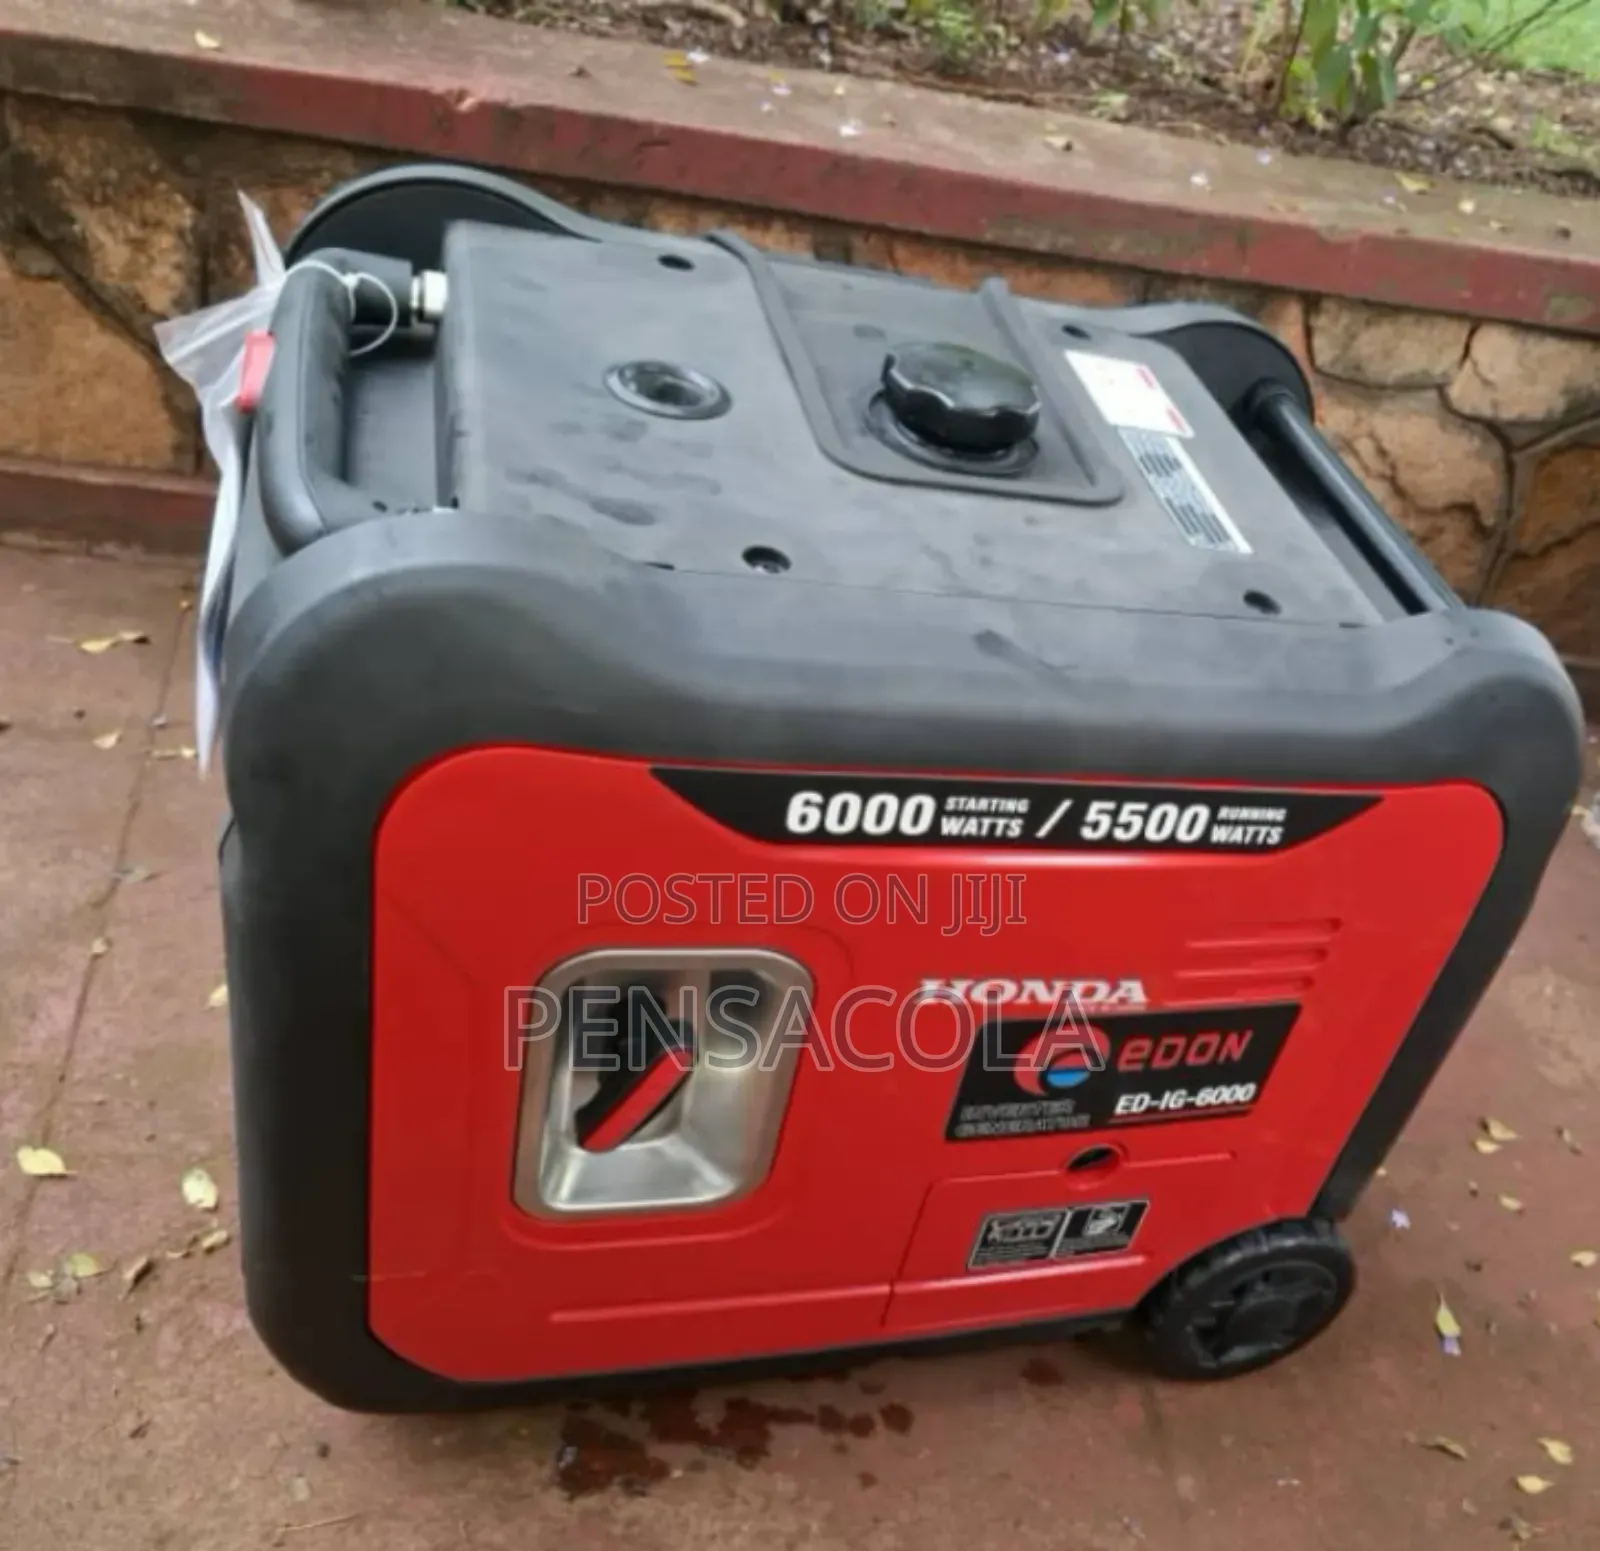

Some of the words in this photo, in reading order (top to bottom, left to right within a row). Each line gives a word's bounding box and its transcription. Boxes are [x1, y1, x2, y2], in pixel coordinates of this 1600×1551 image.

[785, 790, 937, 836] 6000
[945, 796, 1030, 814] STARTING
[940, 815, 1024, 839] WATTS
[1080, 801, 1211, 843] 5500
[1210, 824, 1284, 845] WATTS
[916, 978, 1148, 1004] HONDA
[1114, 1083, 1257, 1116] ED-IG-6000
